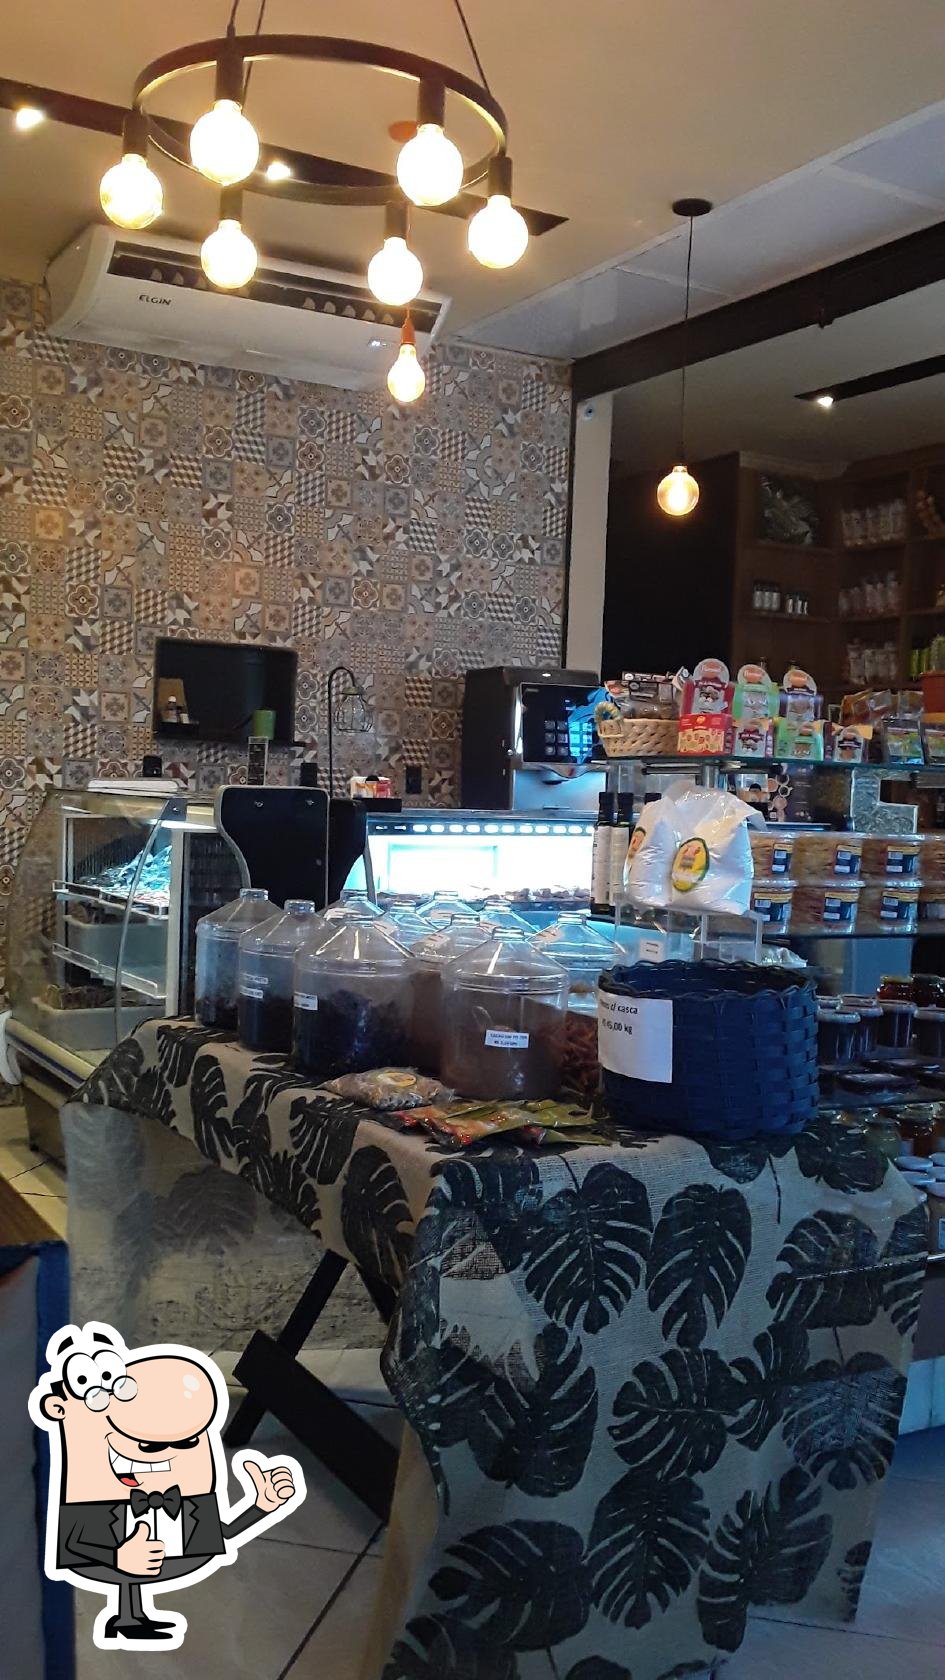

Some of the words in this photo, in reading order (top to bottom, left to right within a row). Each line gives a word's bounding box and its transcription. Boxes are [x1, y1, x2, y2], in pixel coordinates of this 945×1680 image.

[139, 294, 172, 306] ELGIN
[617, 1005, 638, 1015] casca
[624, 1024, 633, 1036] kg
